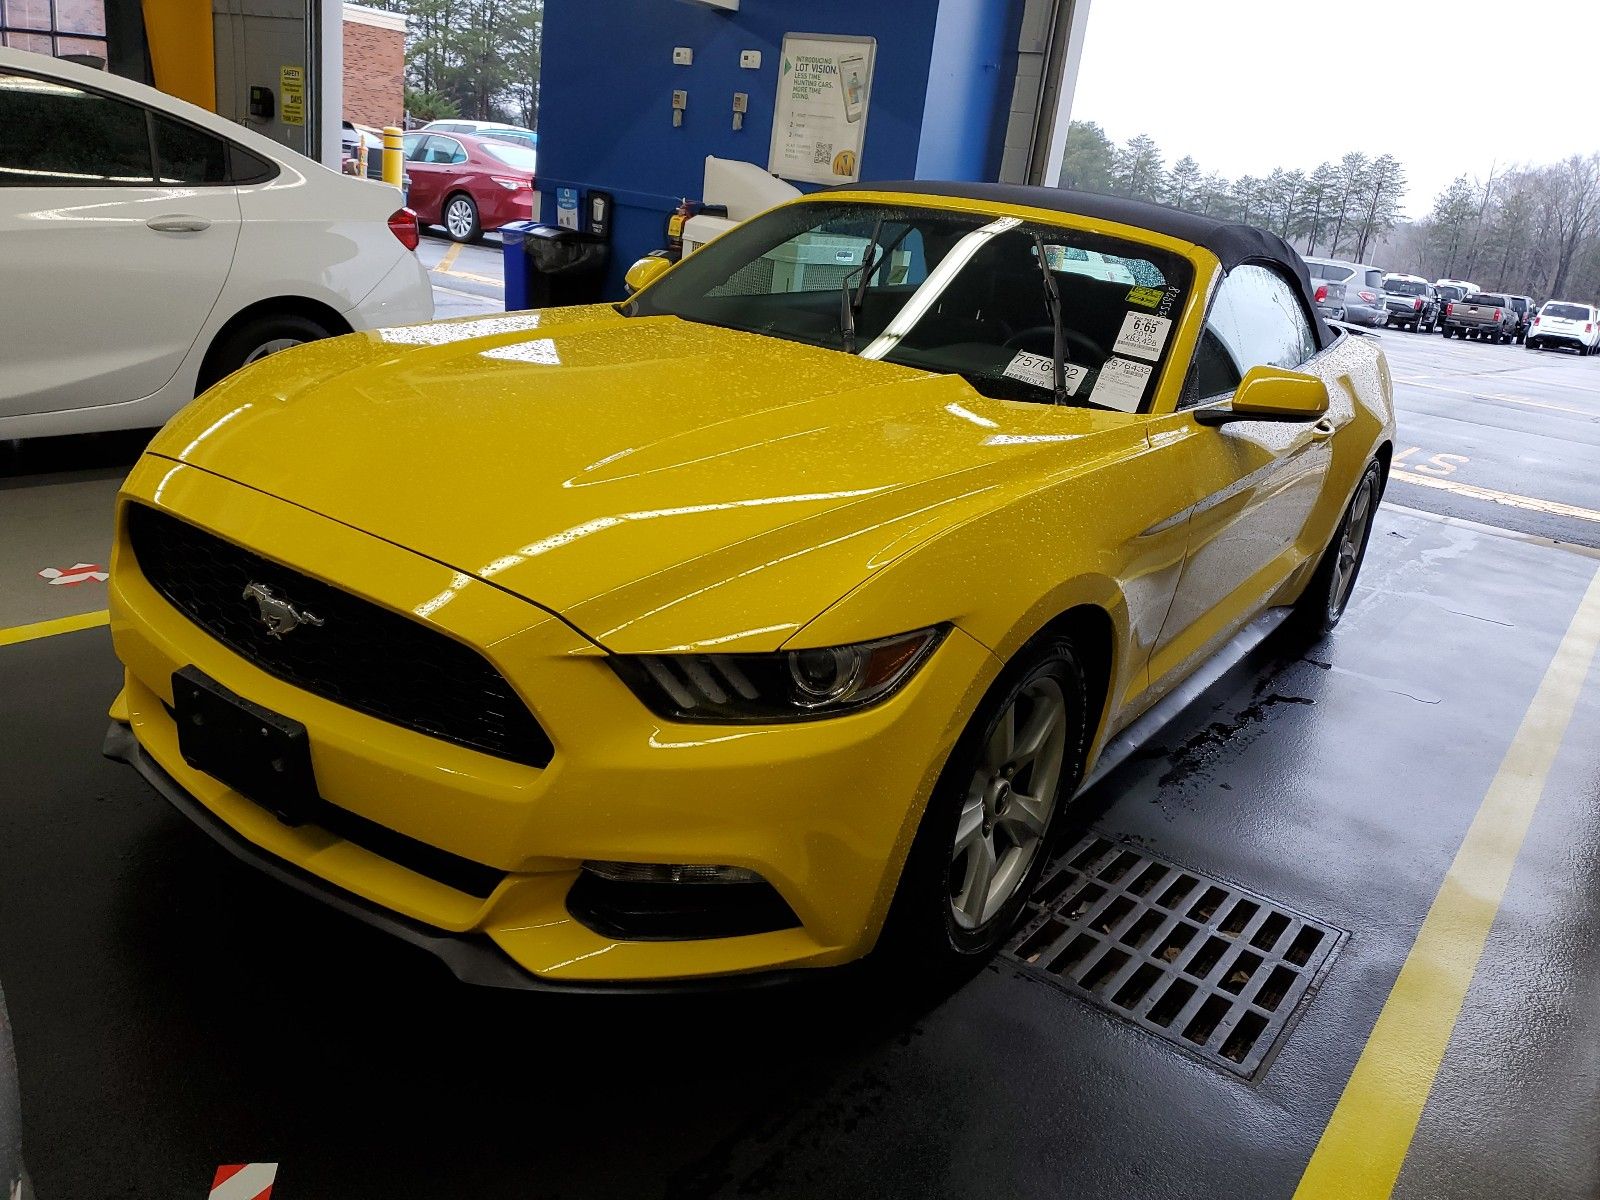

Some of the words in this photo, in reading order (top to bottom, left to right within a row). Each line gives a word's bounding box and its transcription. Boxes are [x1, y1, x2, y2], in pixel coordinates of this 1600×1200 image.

[796, 56, 832, 64] INTRODUCING
[283, 69, 300, 77] SAFETY
[795, 63, 809, 72] LOT
[811, 64, 838, 75] VISION.
[793, 79, 817, 87] HUNTING
[808, 87, 821, 95] TIME
[290, 95, 303, 105] DAYS
[1133, 319, 1157, 334] 6:65
[1014, 353, 1079, 380] 757632
